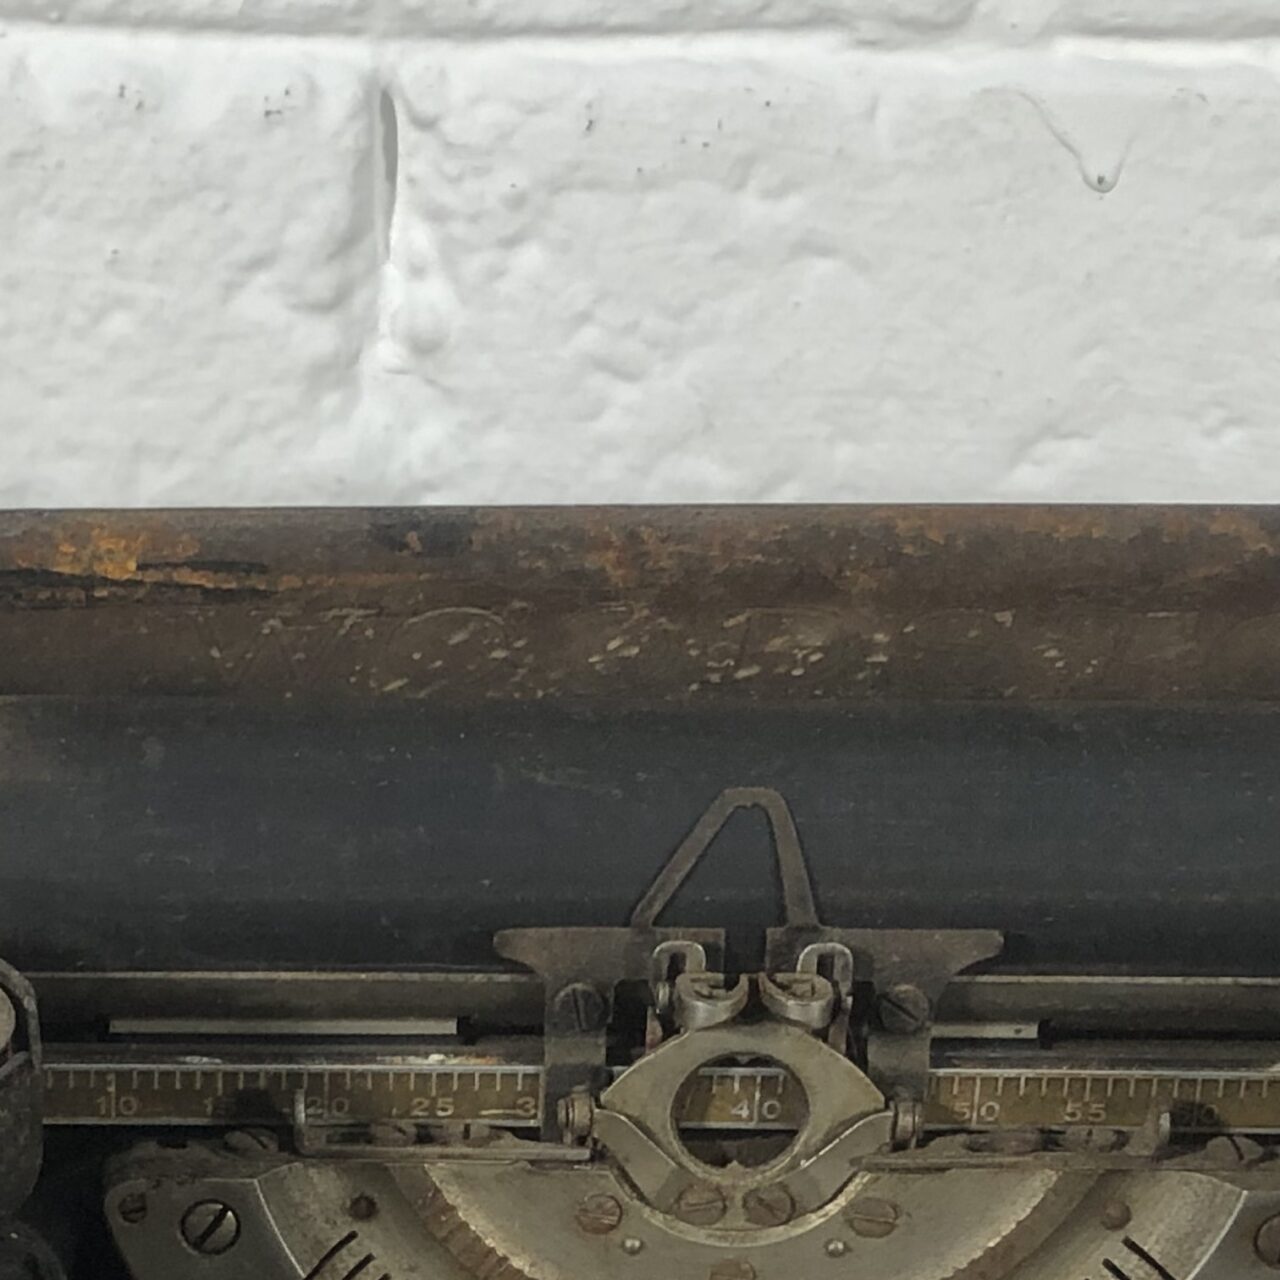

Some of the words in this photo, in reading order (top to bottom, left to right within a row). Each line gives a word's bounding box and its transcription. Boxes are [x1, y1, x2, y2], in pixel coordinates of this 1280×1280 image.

[96, 1096, 139, 1116] 10
[306, 1096, 350, 1116] 20
[410, 1097, 455, 1117] 25
[731, 1099, 781, 1120] 40
[952, 1100, 1001, 1122] 50
[1063, 1102, 1108, 1123] 55
